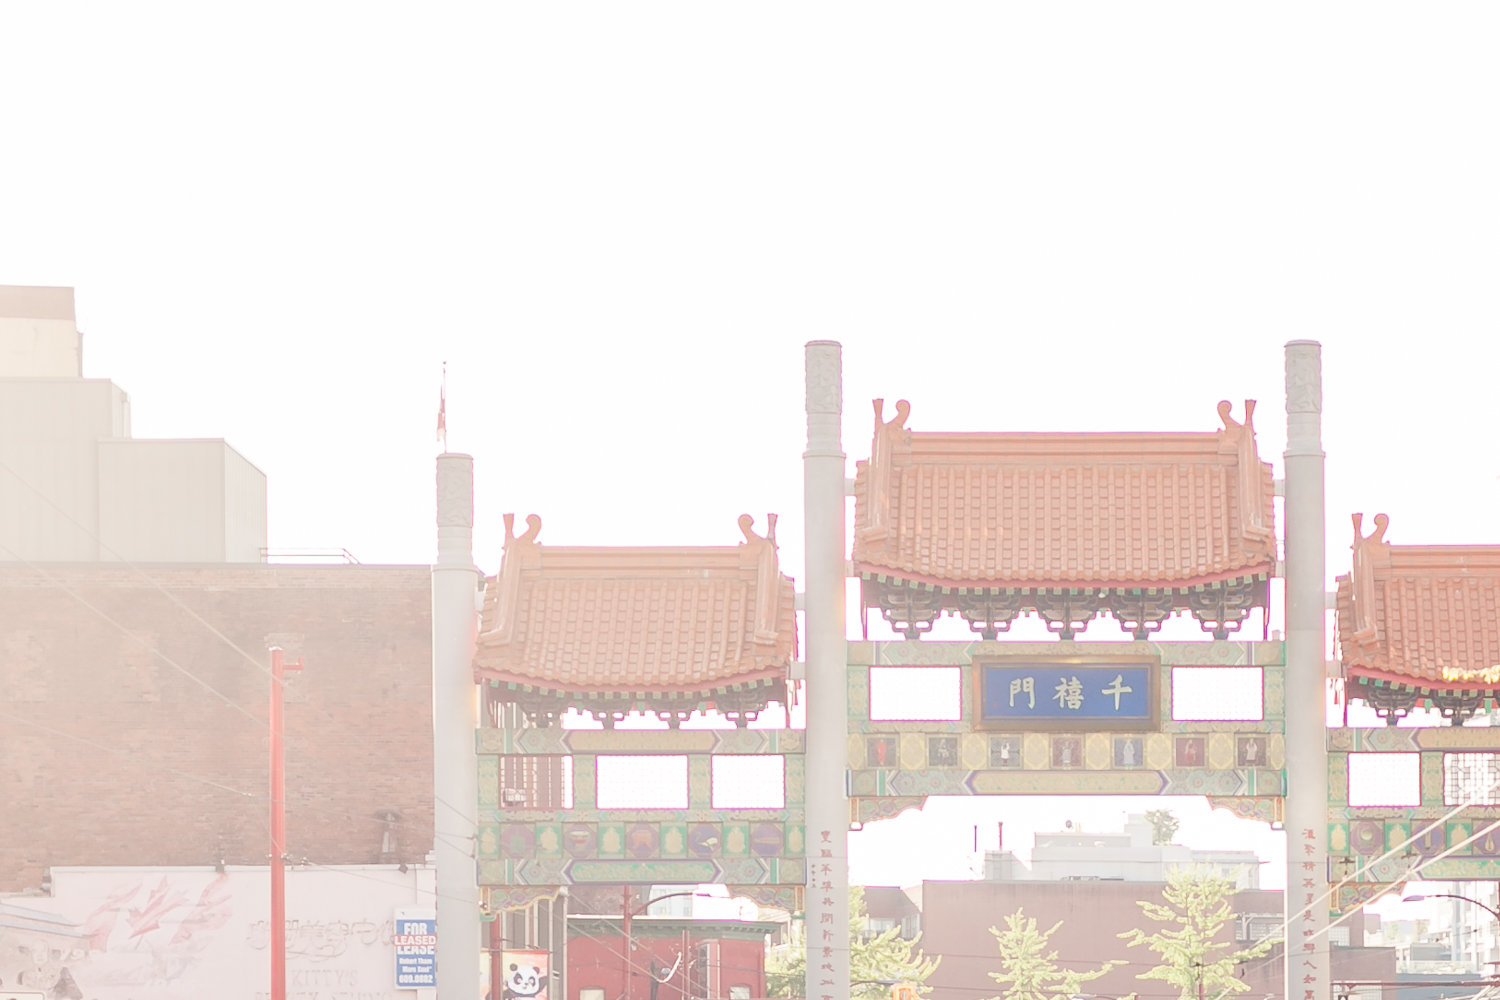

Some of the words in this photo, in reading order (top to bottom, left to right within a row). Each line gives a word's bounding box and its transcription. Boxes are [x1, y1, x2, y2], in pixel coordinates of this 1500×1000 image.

[404, 922, 427, 935] FOR
[394, 936, 436, 946] LEASED
[397, 946, 435, 955] LEASE
[291, 969, 358, 987] KITTY'S
